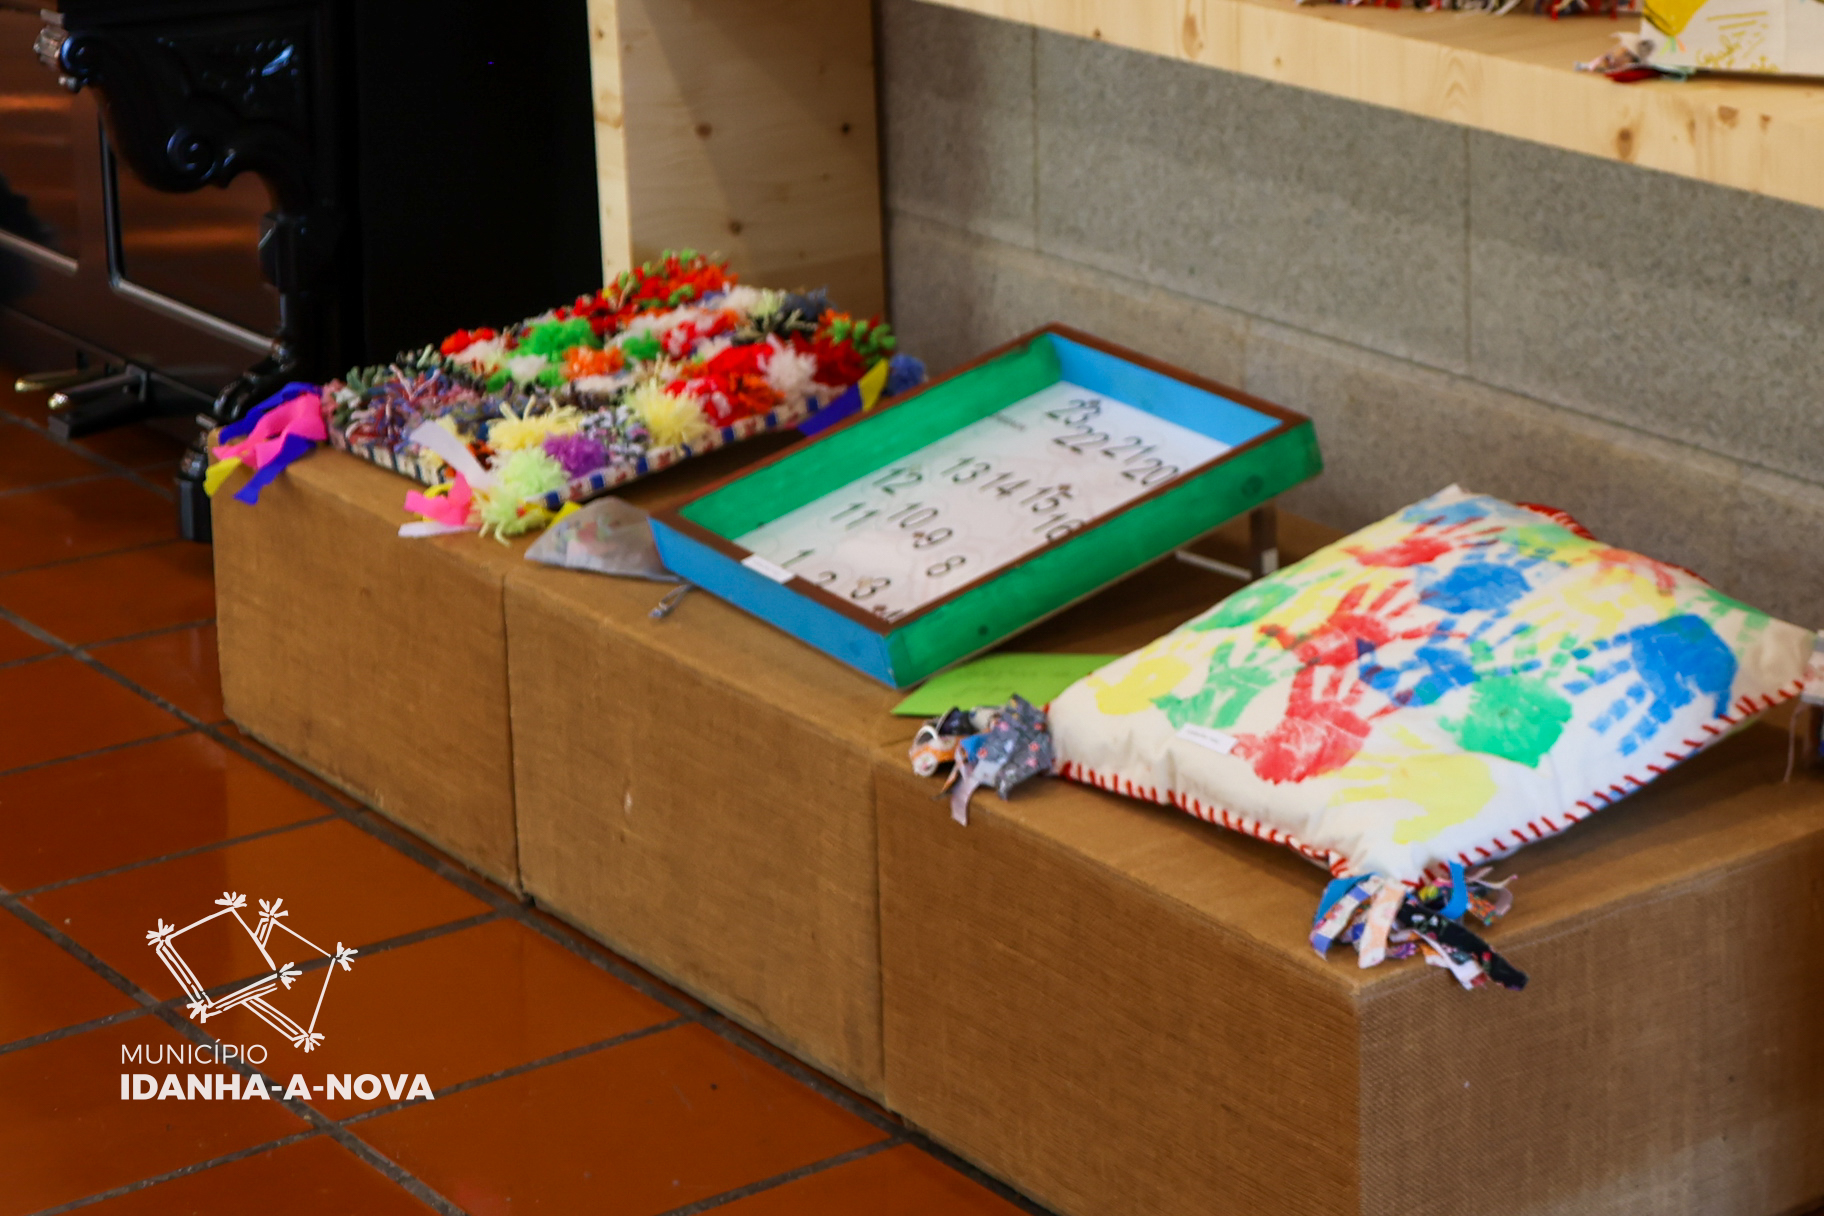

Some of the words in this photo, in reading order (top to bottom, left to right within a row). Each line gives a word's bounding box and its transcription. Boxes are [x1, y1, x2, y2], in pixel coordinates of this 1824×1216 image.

[1046, 398, 1101, 426] 23
[1053, 425, 1110, 455] 22
[1102, 436, 1157, 465] 21
[872, 467, 923, 495] 12
[941, 457, 991, 482] 13
[1121, 458, 1180, 487] 20
[978, 472, 1031, 499] 14
[1019, 485, 1073, 512] 15
[831, 501, 880, 530] 11
[887, 502, 939, 528] 10
[913, 527, 953, 549] 9
[781, 548, 816, 568] 1
[926, 555, 967, 577] 8
[851, 577, 892, 599] 3
